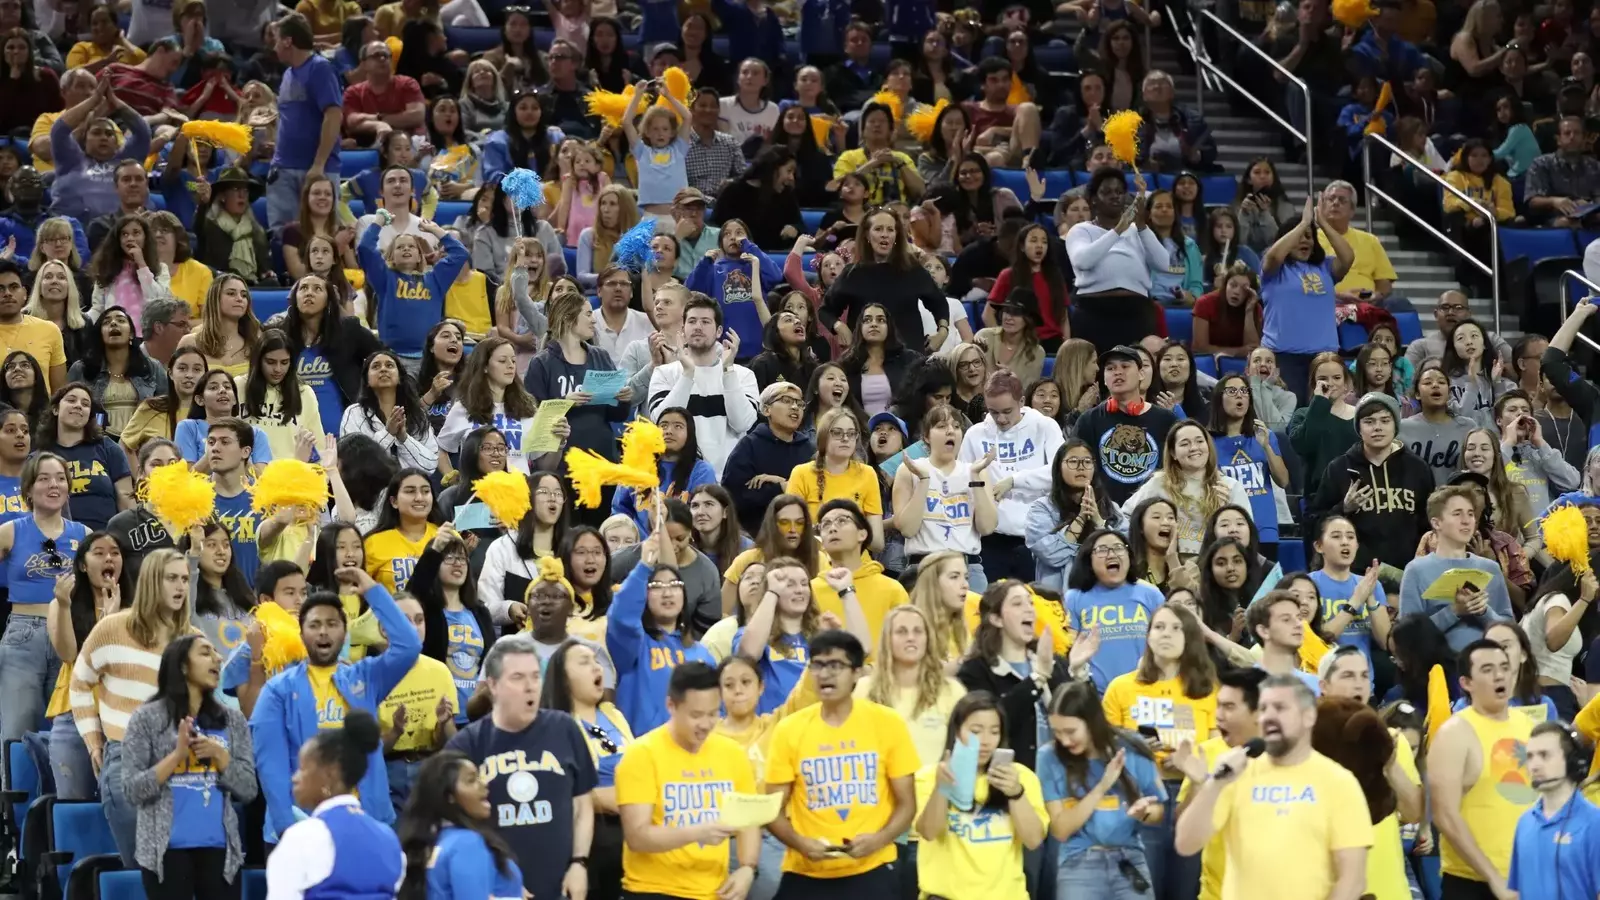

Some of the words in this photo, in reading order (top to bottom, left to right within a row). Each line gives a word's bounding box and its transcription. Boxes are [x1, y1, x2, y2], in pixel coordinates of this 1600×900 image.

[397, 277, 432, 300] Ucla
[68, 460, 108, 477] CLA
[1100, 447, 1159, 472] STOMP
[1080, 603, 1149, 630] UCLA
[479, 749, 566, 785] UCLA
[800, 751, 879, 787] SOUTH
[806, 782, 879, 811] CAMPUS
[1252, 784, 1317, 804] UCLA
[497, 800, 553, 827] DAD
